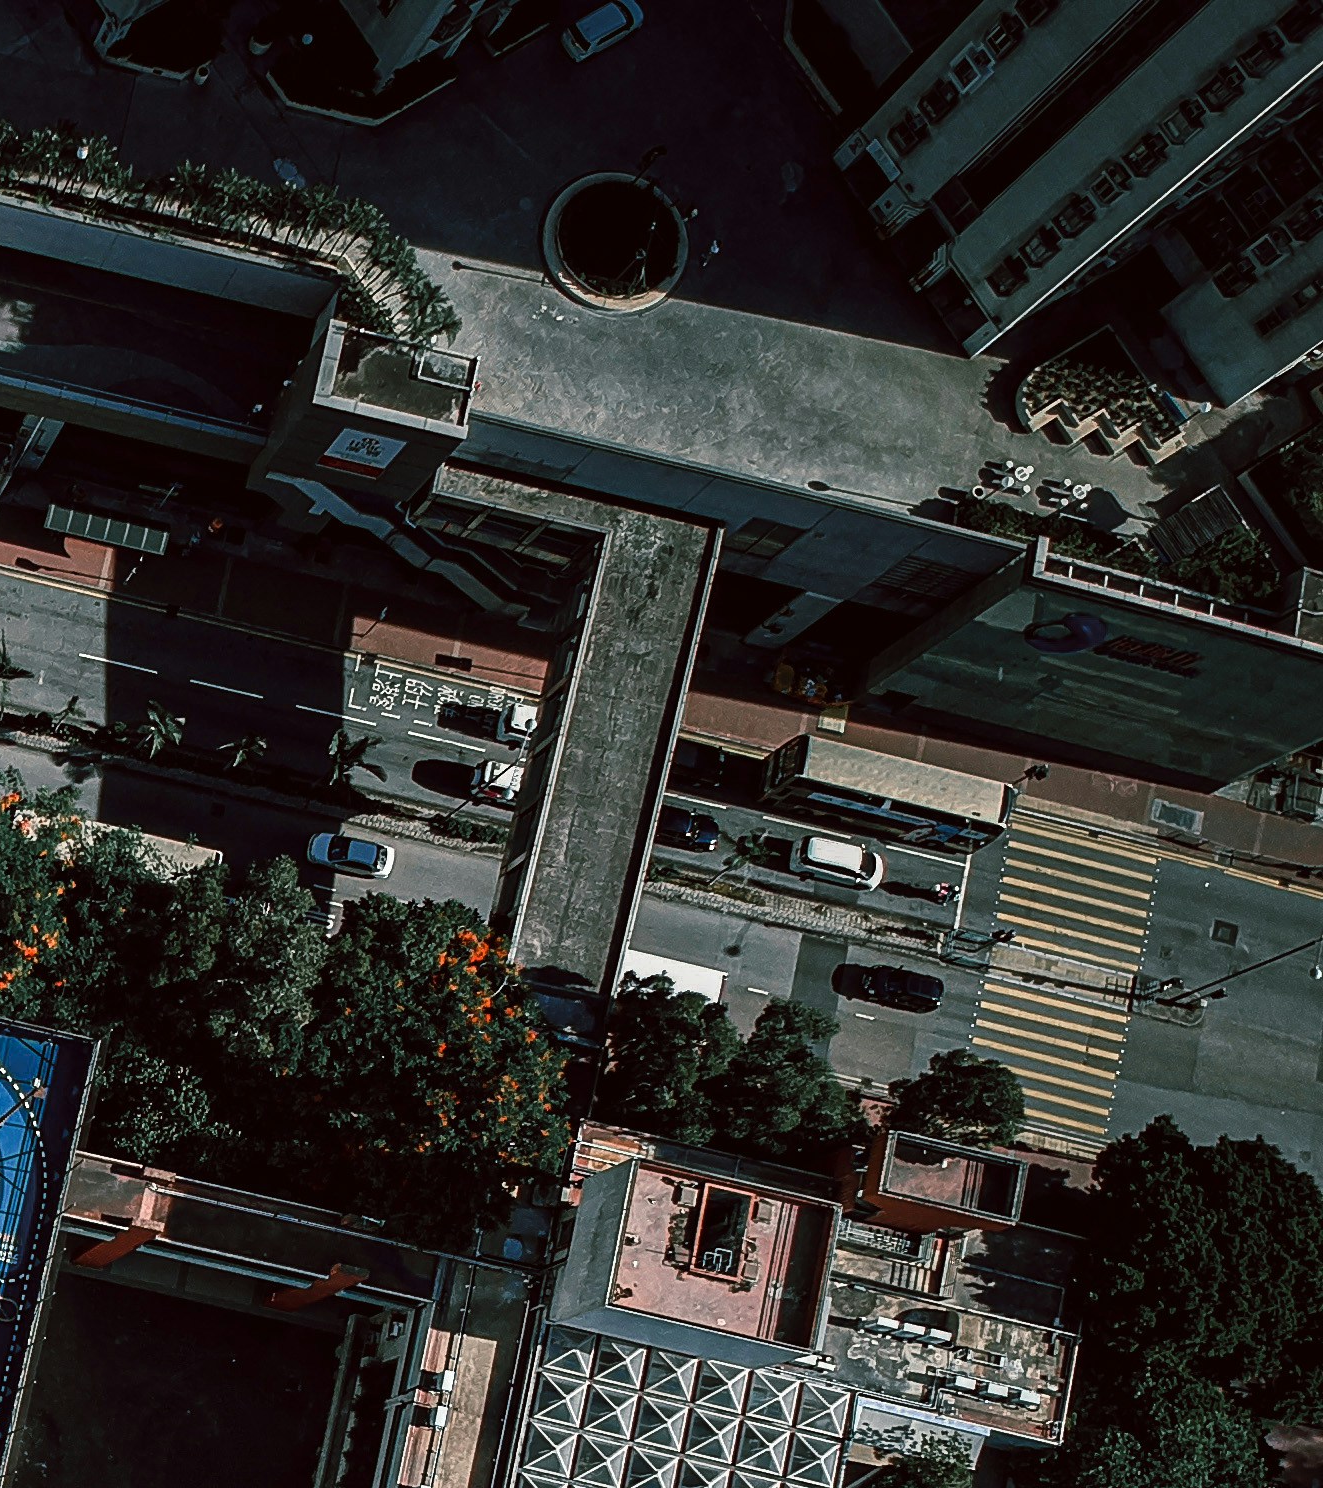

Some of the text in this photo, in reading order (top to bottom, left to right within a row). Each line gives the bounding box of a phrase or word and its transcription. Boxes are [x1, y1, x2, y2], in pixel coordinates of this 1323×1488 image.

[368, 662, 402, 709] 上落客
[401, 677, 432, 710] 的士
[463, 693, 485, 721] ONLY
